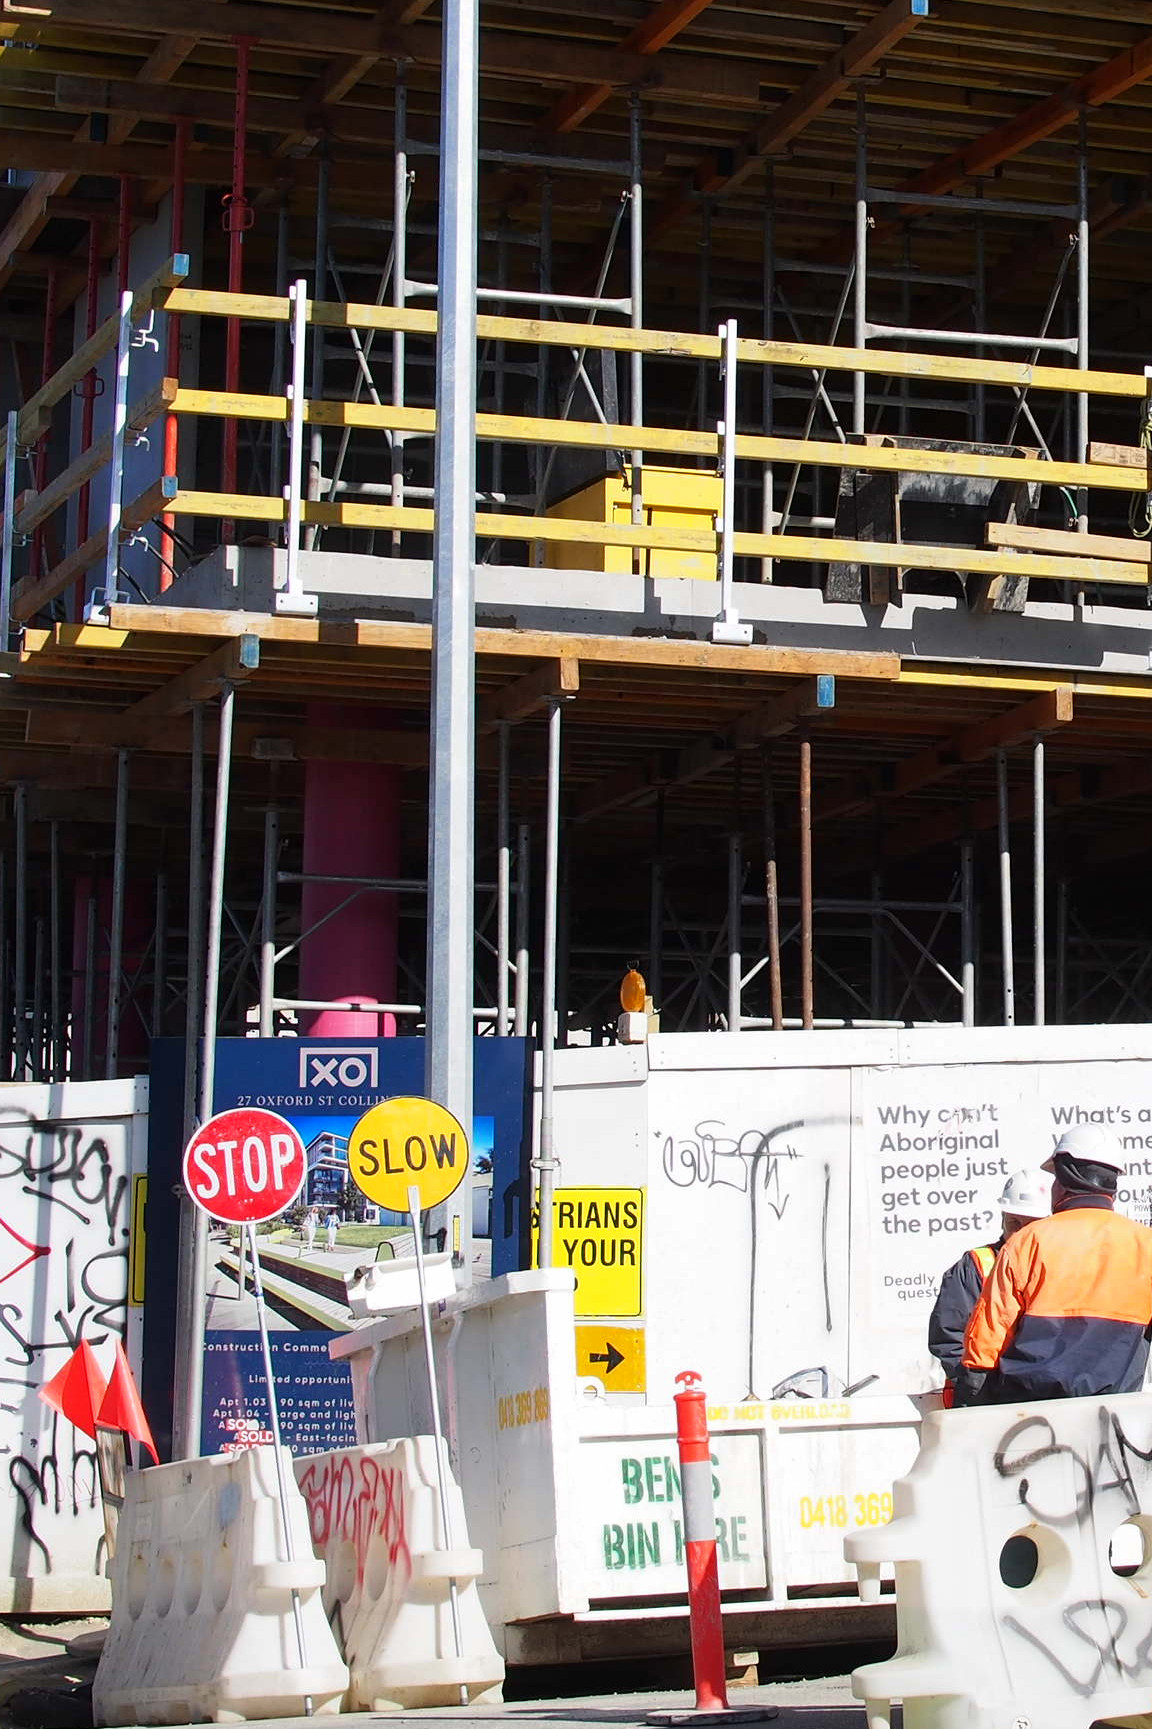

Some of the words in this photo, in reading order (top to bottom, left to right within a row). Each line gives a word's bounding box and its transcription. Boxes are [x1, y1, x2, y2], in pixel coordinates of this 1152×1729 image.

[237, 1095, 251, 1106] 27
[256, 1095, 313, 1106] OXFORD
[318, 1095, 334, 1106] ST
[877, 1105, 931, 1128] Why
[938, 1104, 999, 1123] cn't
[1051, 1105, 1132, 1125] What's
[1138, 1108, 1152, 1123] a
[880, 1130, 1000, 1155] Aboriginal
[358, 1133, 457, 1177] SLOW
[193, 1134, 296, 1200] STOP
[881, 1157, 960, 1184] people
[964, 1156, 1008, 1181] just
[882, 1189, 920, 1212] get
[926, 1189, 978, 1205] over
[882, 1215, 922, 1235] the
[928, 1211, 993, 1237] past?
[563, 1238, 637, 1267] YOUR
[884, 1274, 936, 1289] Deadly
[203, 1343, 279, 1352] onstructin
[249, 1375, 290, 1384] Limted
[213, 1409, 233, 1420] Apt
[237, 1409, 260, 1418] 1.04
[279, 1410, 305, 1420] arge
[310, 1409, 330, 1418] and
[219, 1398, 239, 1409] Apt
[244, 1398, 266, 1407] 1.03
[280, 1398, 294, 1407] 90
[298, 1400, 320, 1410] sqm
[324, 1398, 336, 1407] of
[733, 1404, 765, 1421] NOT
[240, 1431, 274, 1443] SOLD
[280, 1422, 294, 1430] 90
[298, 1423, 320, 1433] sqm
[324, 1421, 336, 1430] of
[800, 1494, 848, 1528] 0418
[855, 1492, 893, 1526] 369
[603, 1521, 662, 1570] BIN
[674, 1516, 750, 1567] RE
